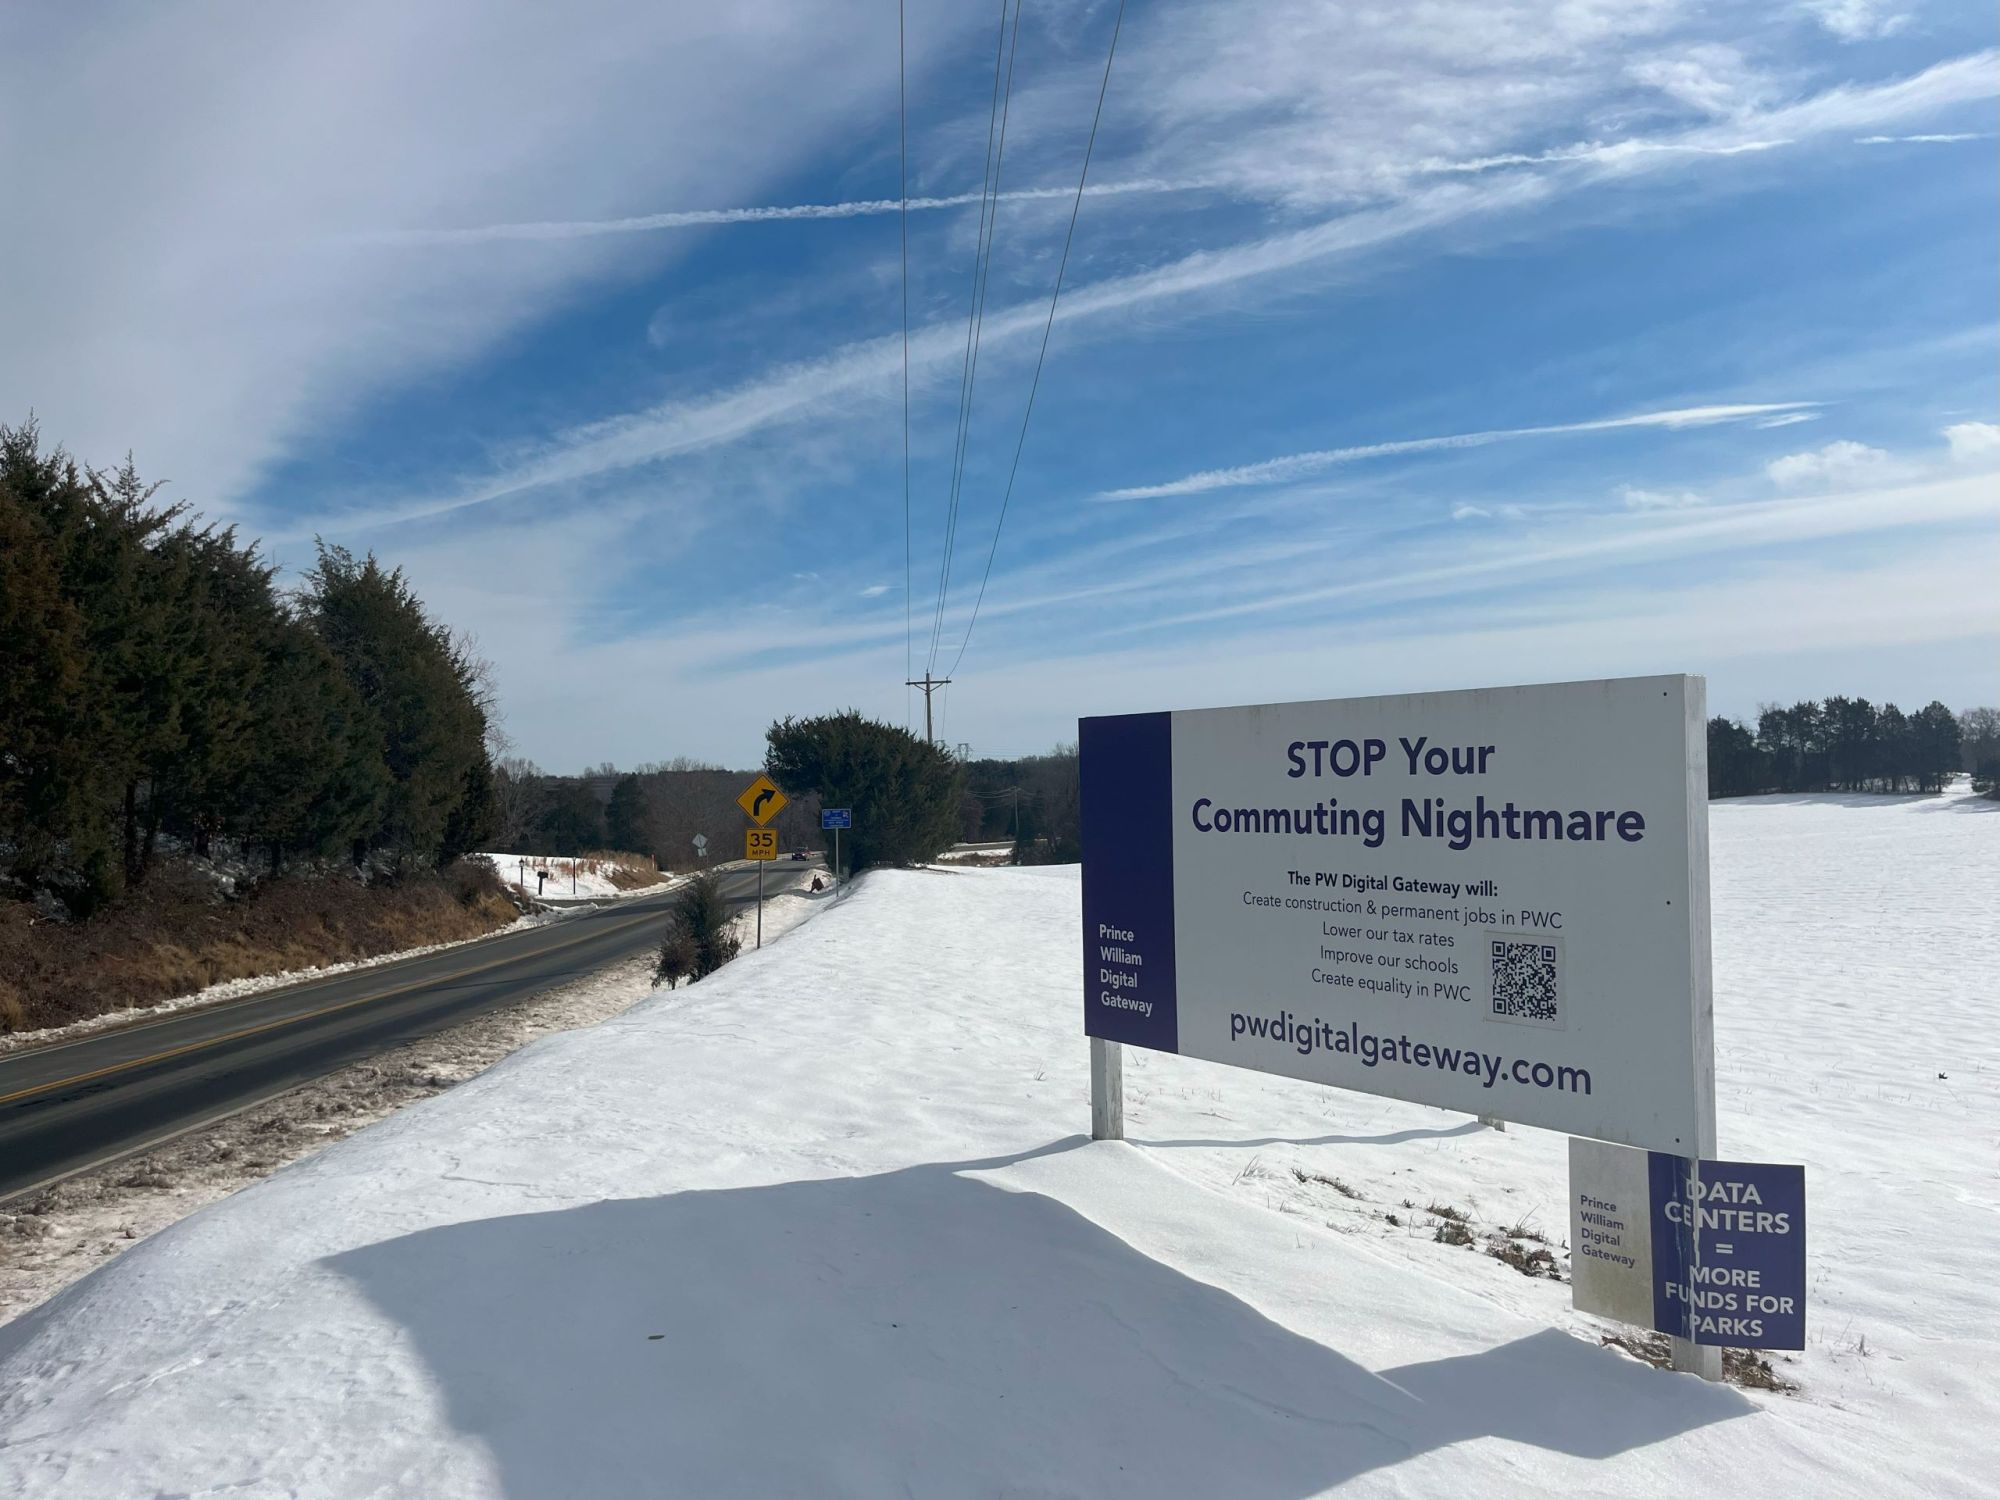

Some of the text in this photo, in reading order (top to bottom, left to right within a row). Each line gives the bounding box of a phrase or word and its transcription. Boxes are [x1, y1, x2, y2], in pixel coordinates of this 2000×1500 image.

[1287, 737, 1496, 778] STOP Your
[1192, 796, 1646, 850] Commuting Nightmare
[750, 833, 773, 847] 35
[1287, 871, 1498, 899] The PW Digital Gateway will:
[1243, 891, 1563, 929] Create construction & permanent jobs in PWC
[1099, 924, 1134, 941] Prince
[1323, 921, 1455, 947] Lower our tax rates
[1100, 946, 1142, 966] William
[1320, 945, 1459, 974] Improve our schools
[1100, 968, 1137, 989] Digital
[1311, 968, 1472, 1002] Create equality in PWC
[1101, 991, 1152, 1018] Gateway
[1230, 1010, 1592, 1095] pwdigitalgateway.com
[1580, 1195, 1617, 1212] Prince
[1686, 1178, 1763, 1205] DATA
[1580, 1210, 1624, 1230] William
[1664, 1201, 1790, 1234] CENTERS
[1581, 1227, 1620, 1246] Digital
[1715, 1243, 1733, 1254] =
[1581, 1244, 1635, 1269] Gateway
[1689, 1265, 1761, 1288] MORE
[1665, 1281, 1794, 1314] FUNDS FOR
[1689, 1312, 1763, 1337] PARKS
